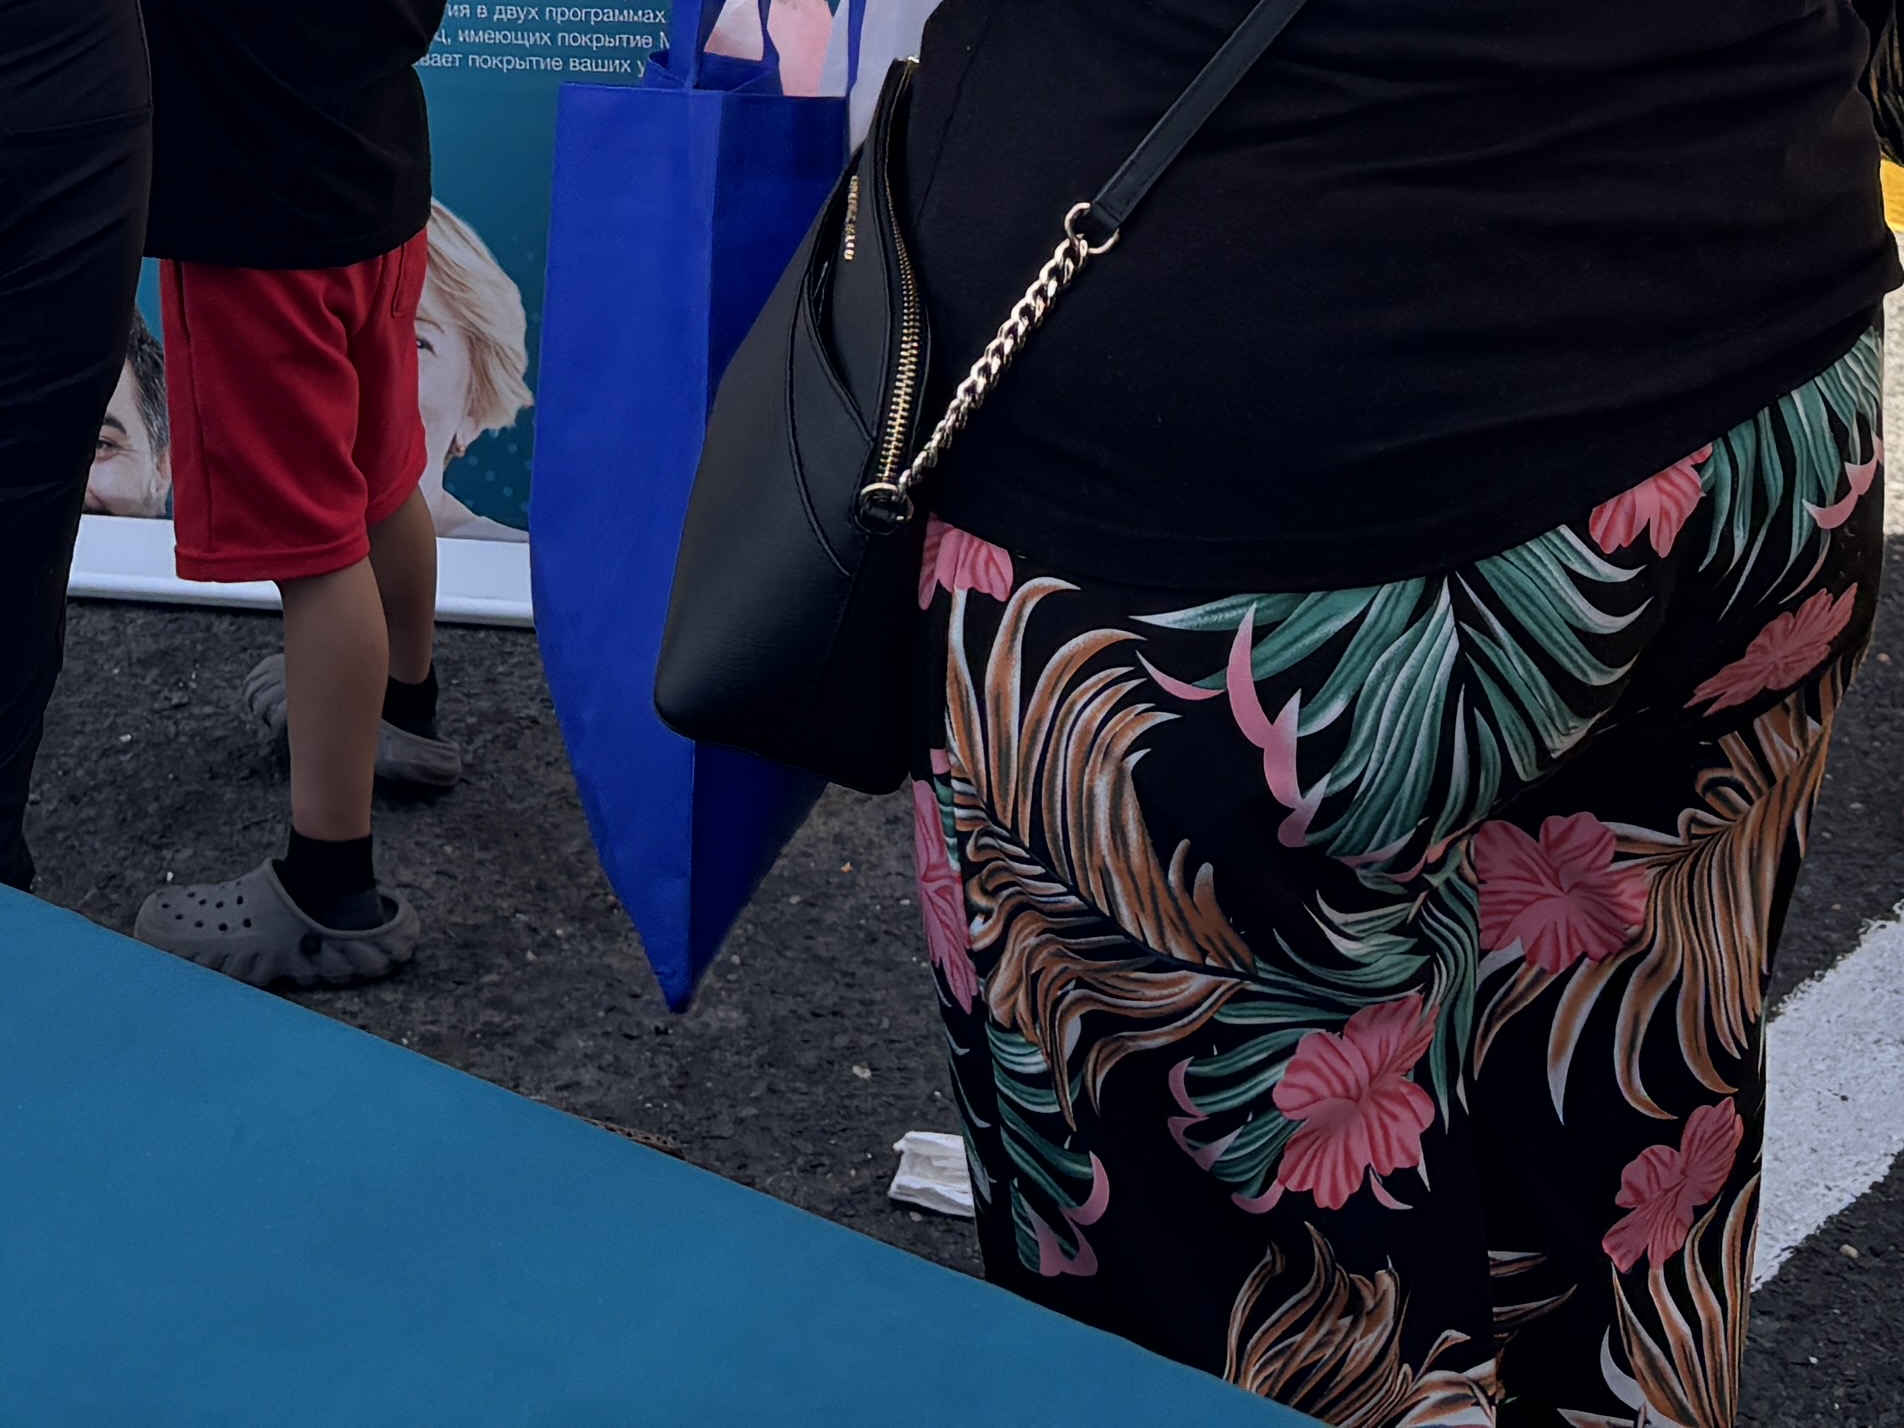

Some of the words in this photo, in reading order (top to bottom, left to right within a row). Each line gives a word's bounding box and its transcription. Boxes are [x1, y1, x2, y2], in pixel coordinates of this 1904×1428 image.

[477, 5, 487, 17] в
[493, 5, 539, 23] двух
[546, 7, 666, 24] программах
[458, 30, 551, 48] имеющих
[558, 32, 652, 51] покрытие
[469, 54, 563, 74] покрытие
[569, 57, 631, 73] ваших
